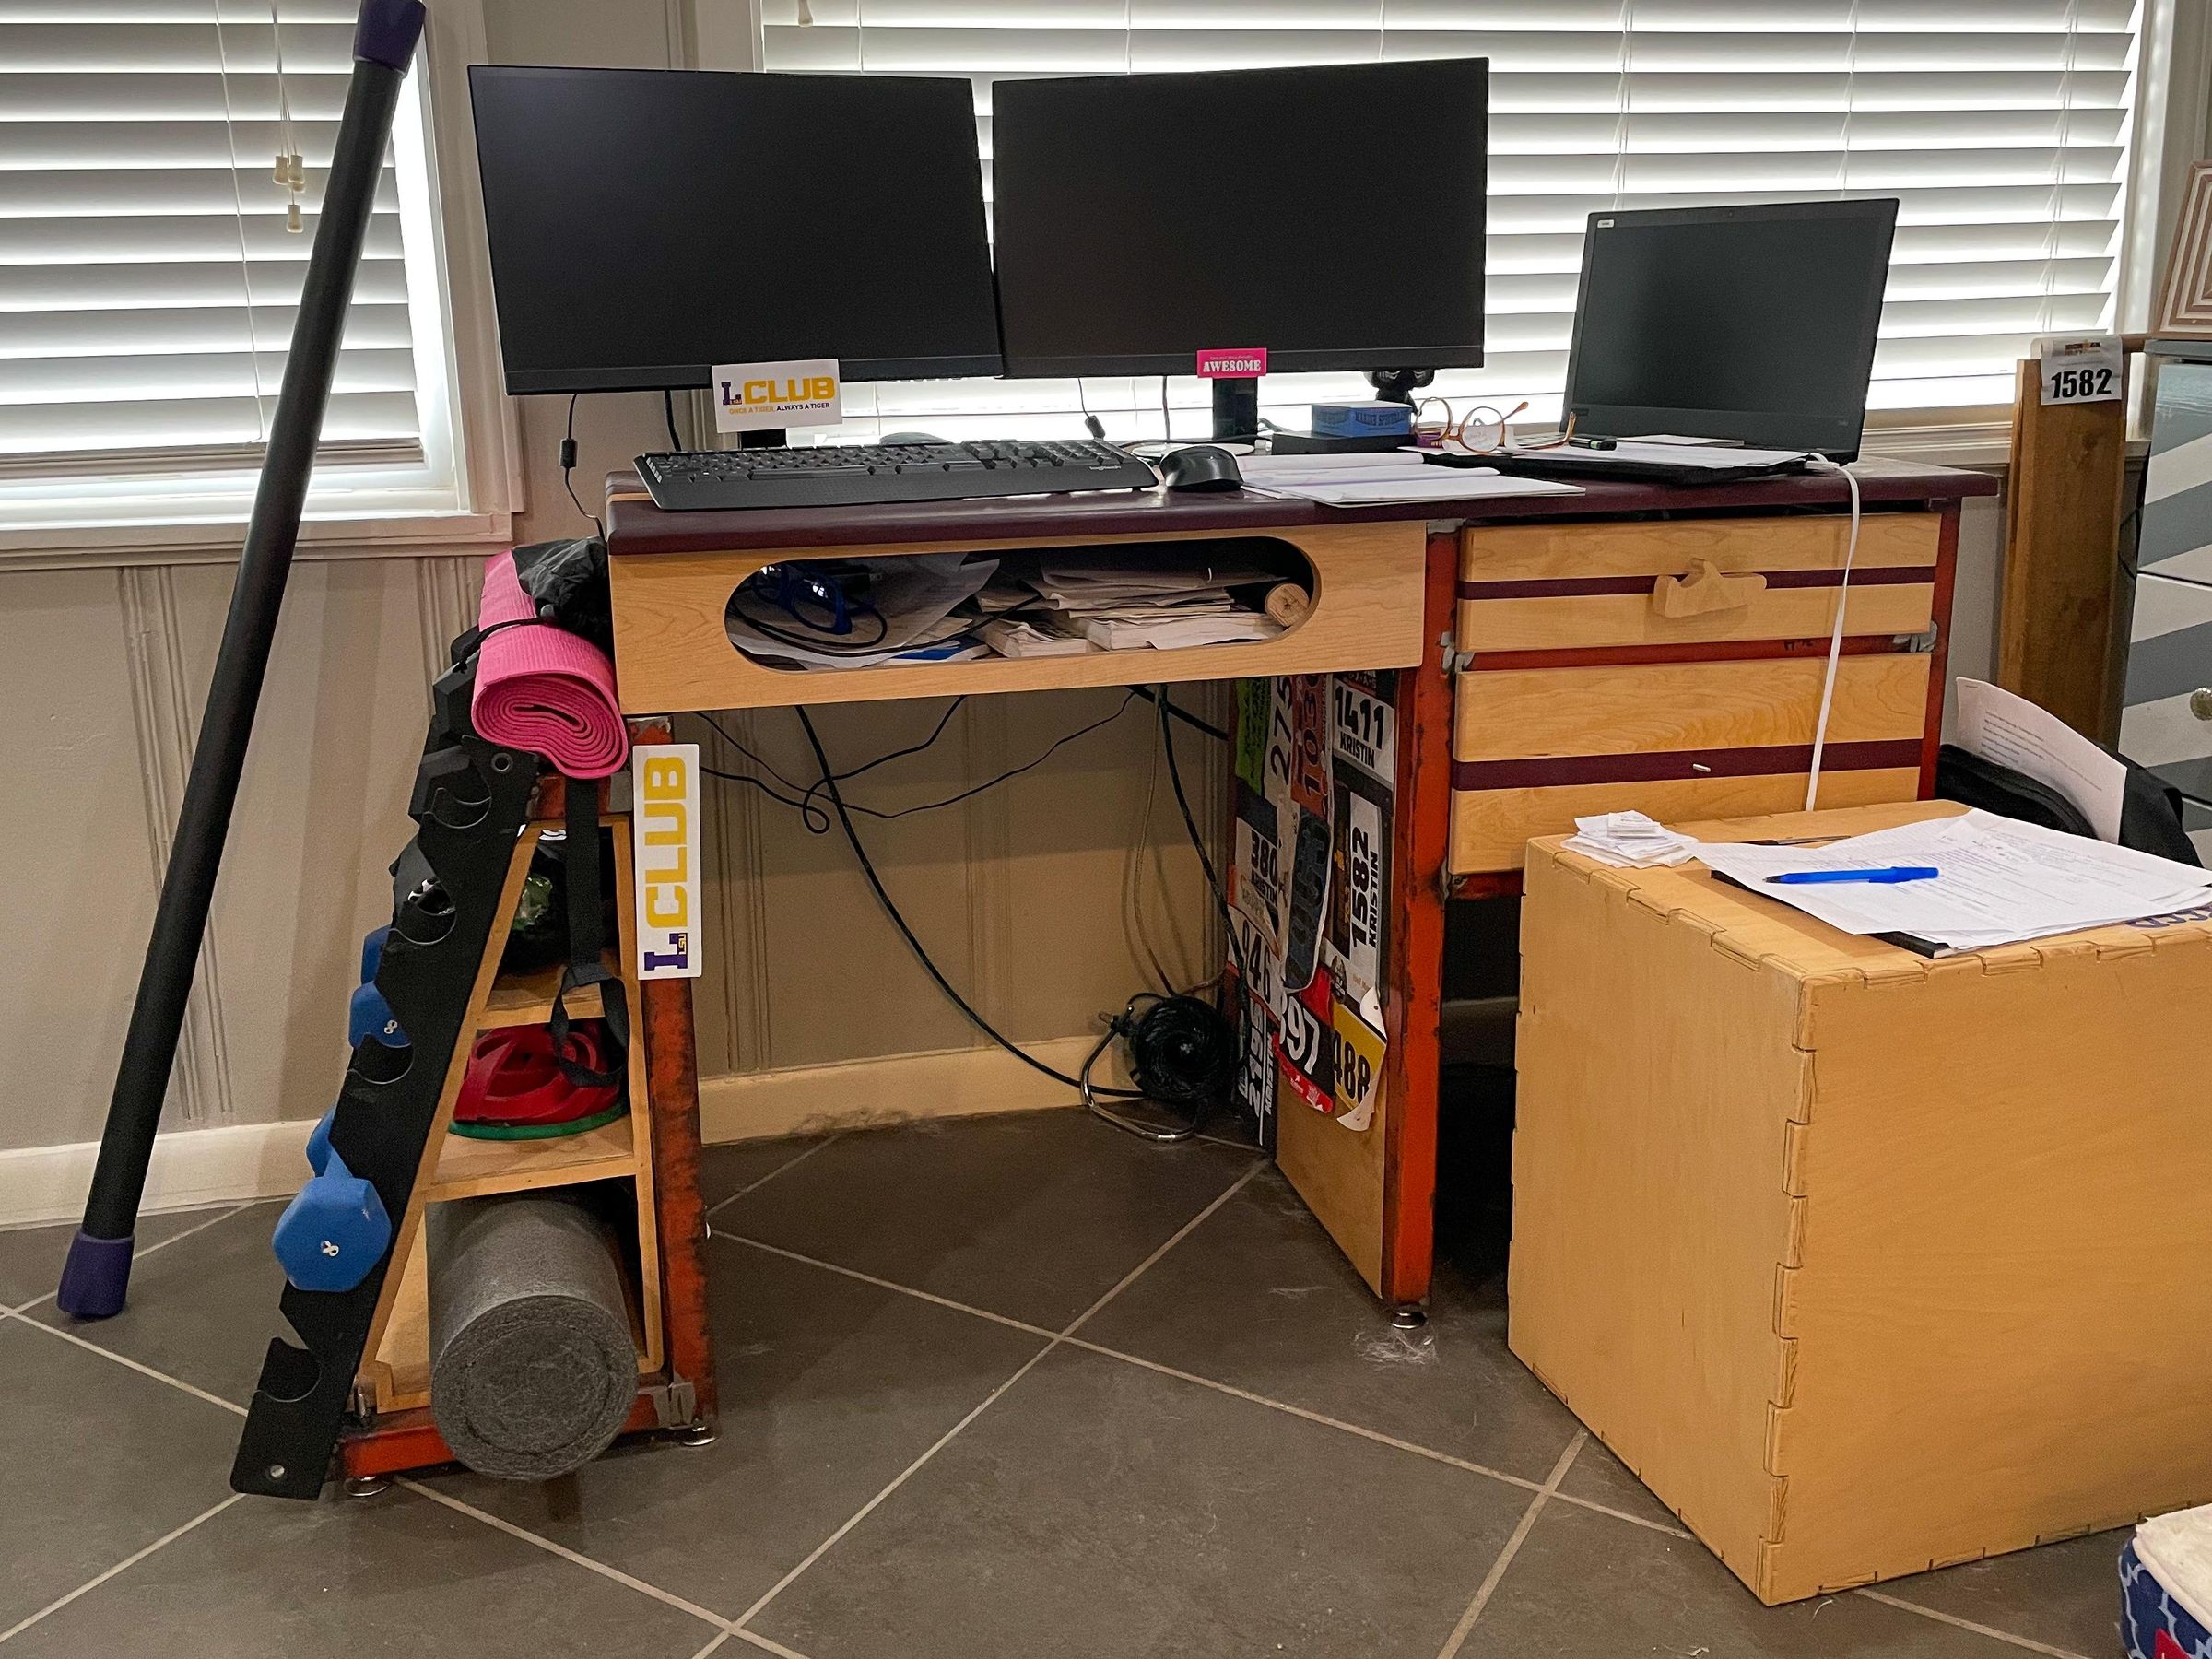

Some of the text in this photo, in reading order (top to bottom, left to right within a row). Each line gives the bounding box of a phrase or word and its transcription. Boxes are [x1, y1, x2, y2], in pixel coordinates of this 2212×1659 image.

[1203, 360, 1261, 372] AWESOME
[2051, 369, 2112, 398] 1582
[777, 404, 804, 412] ALWAYS
[1335, 686, 1384, 749] 1411
[1340, 732, 1375, 769] KRISTIN
[644, 757, 688, 928] CLUB
[1351, 826, 1370, 948] 1582
[1368, 851, 1379, 948] KRISTIN
[383, 1019, 398, 1035] 8
